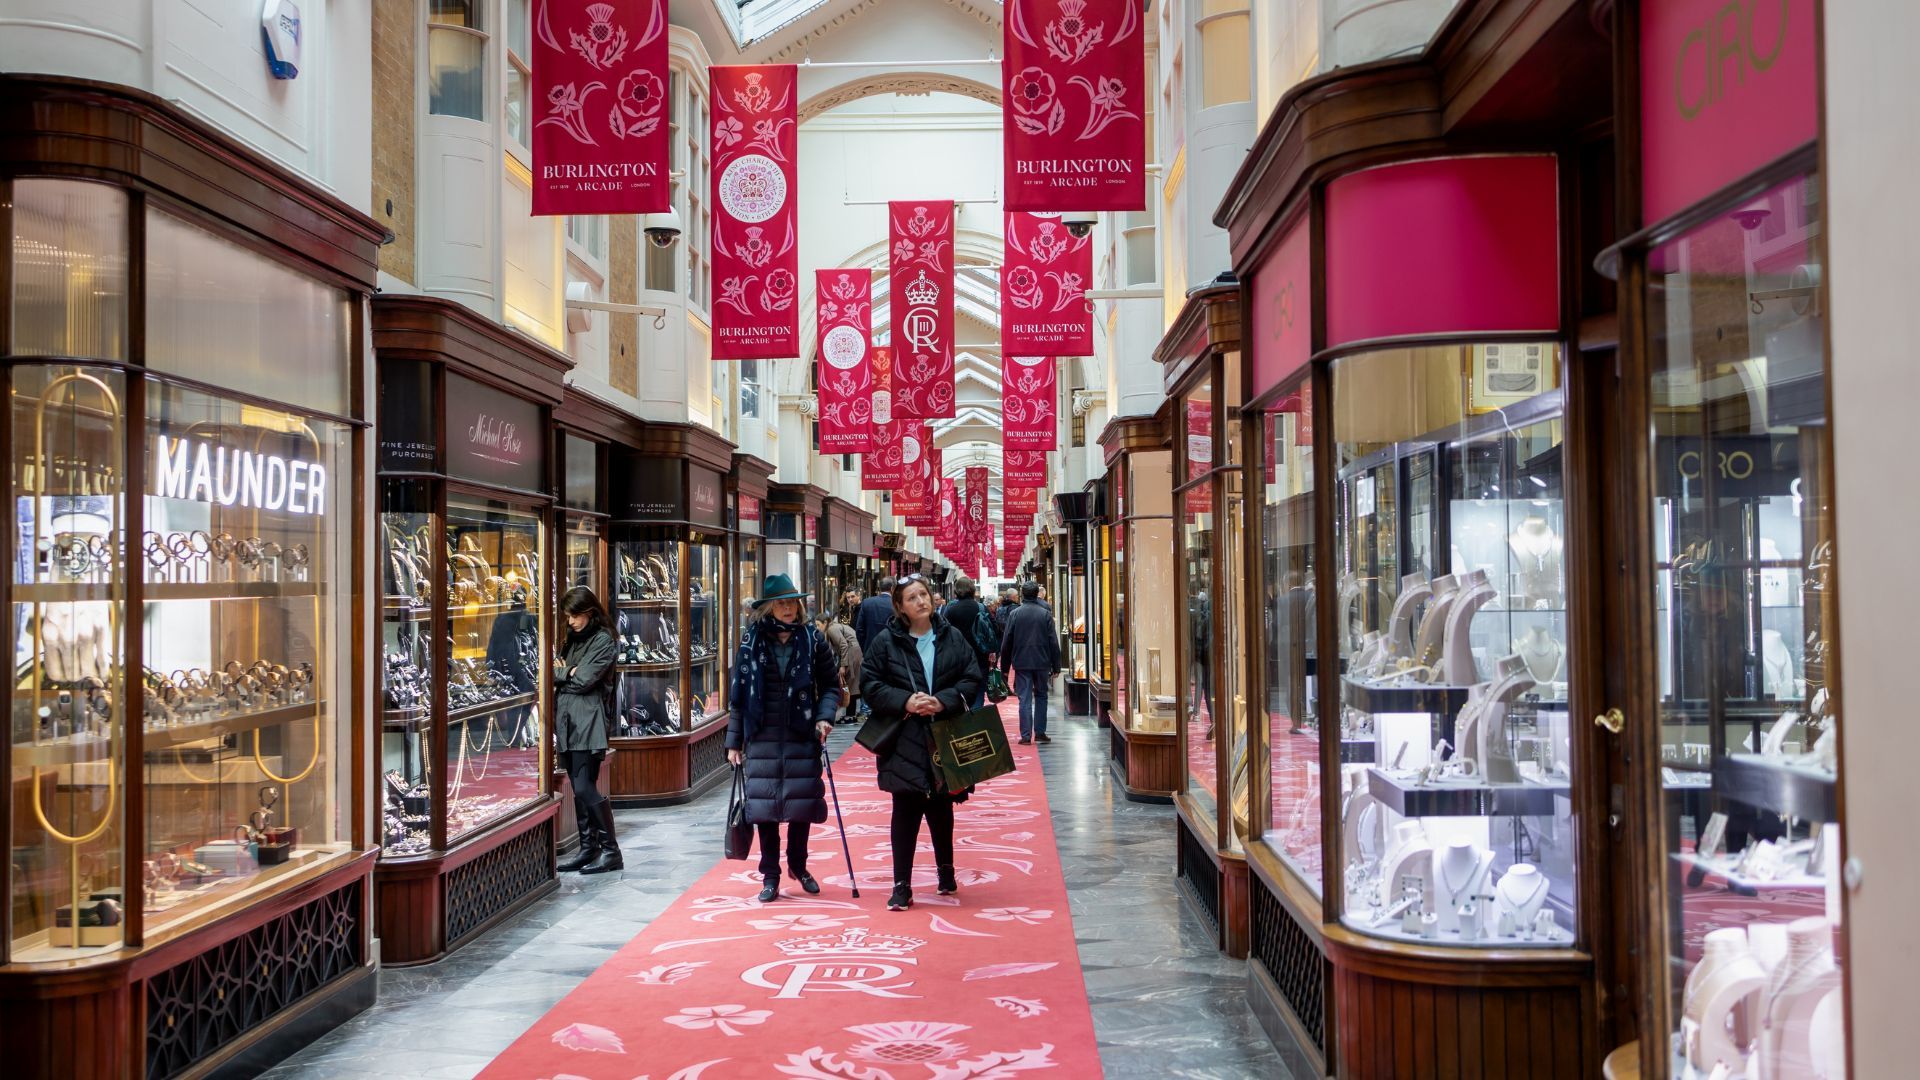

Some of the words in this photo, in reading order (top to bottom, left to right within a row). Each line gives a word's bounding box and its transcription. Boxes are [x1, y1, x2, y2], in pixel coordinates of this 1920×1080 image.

[543, 162, 657, 179] BURLINGTON
[1016, 159, 1132, 174] BURLINGTON
[575, 181, 623, 191] ARCADE
[1049, 177, 1098, 187] ARCADE
[719, 326, 791, 337] BURLINGTON
[1012, 323, 1086, 334] BURLINGTON
[740, 337, 770, 345] ARCADE
[1033, 334, 1064, 342] ARCADE
[823, 433, 869, 441] BURLINGTON
[1006, 430, 1053, 438] BURLINGTON
[381, 441, 402, 449] FINE
[157, 434, 326, 516] MAUNDER
